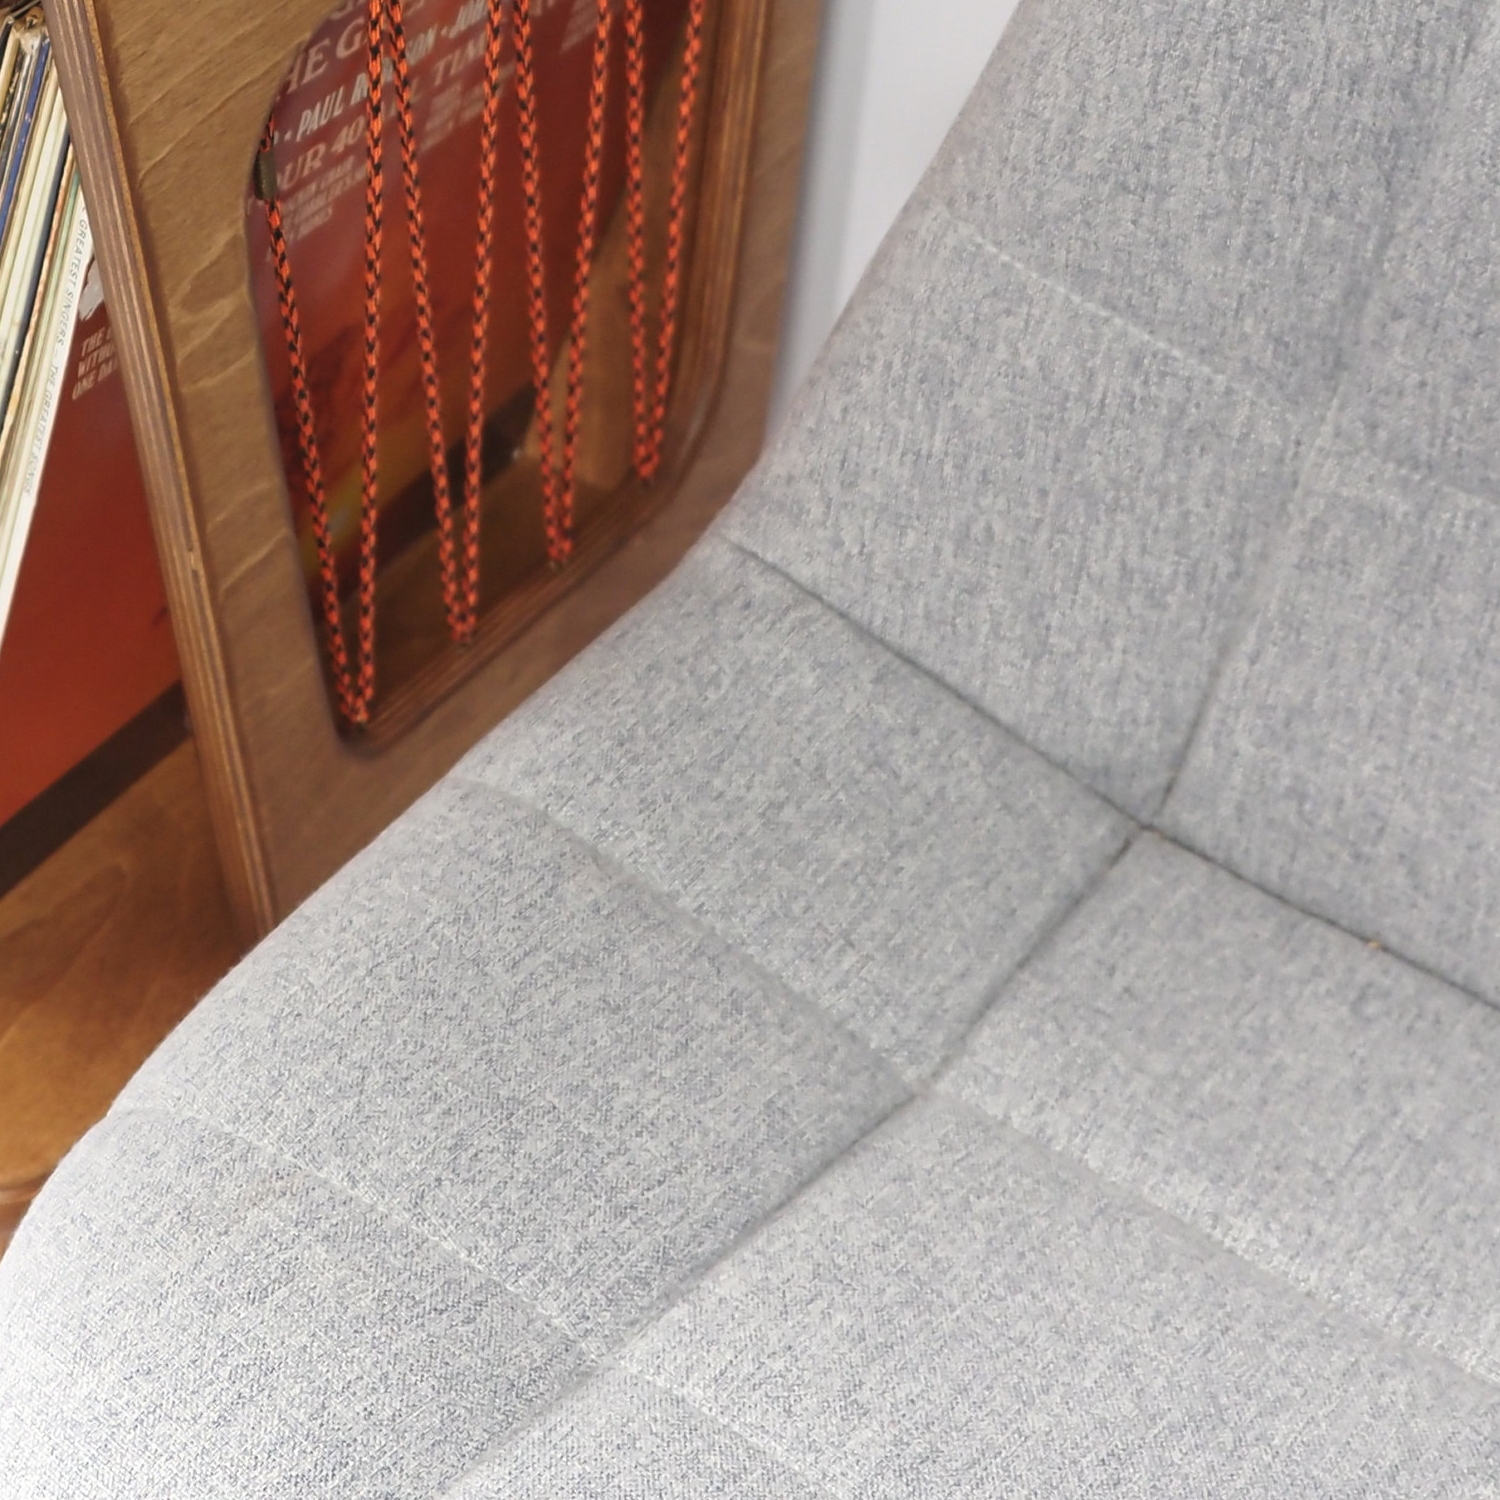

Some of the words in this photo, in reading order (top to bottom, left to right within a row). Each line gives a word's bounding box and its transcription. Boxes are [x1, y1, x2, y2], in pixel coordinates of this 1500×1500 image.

[296, 86, 346, 143] PAUL
[331, 114, 367, 155] 40
[68, 219, 88, 288] GREATEST
[56, 288, 74, 347] SINGERS
[47, 364, 59, 387] THE
